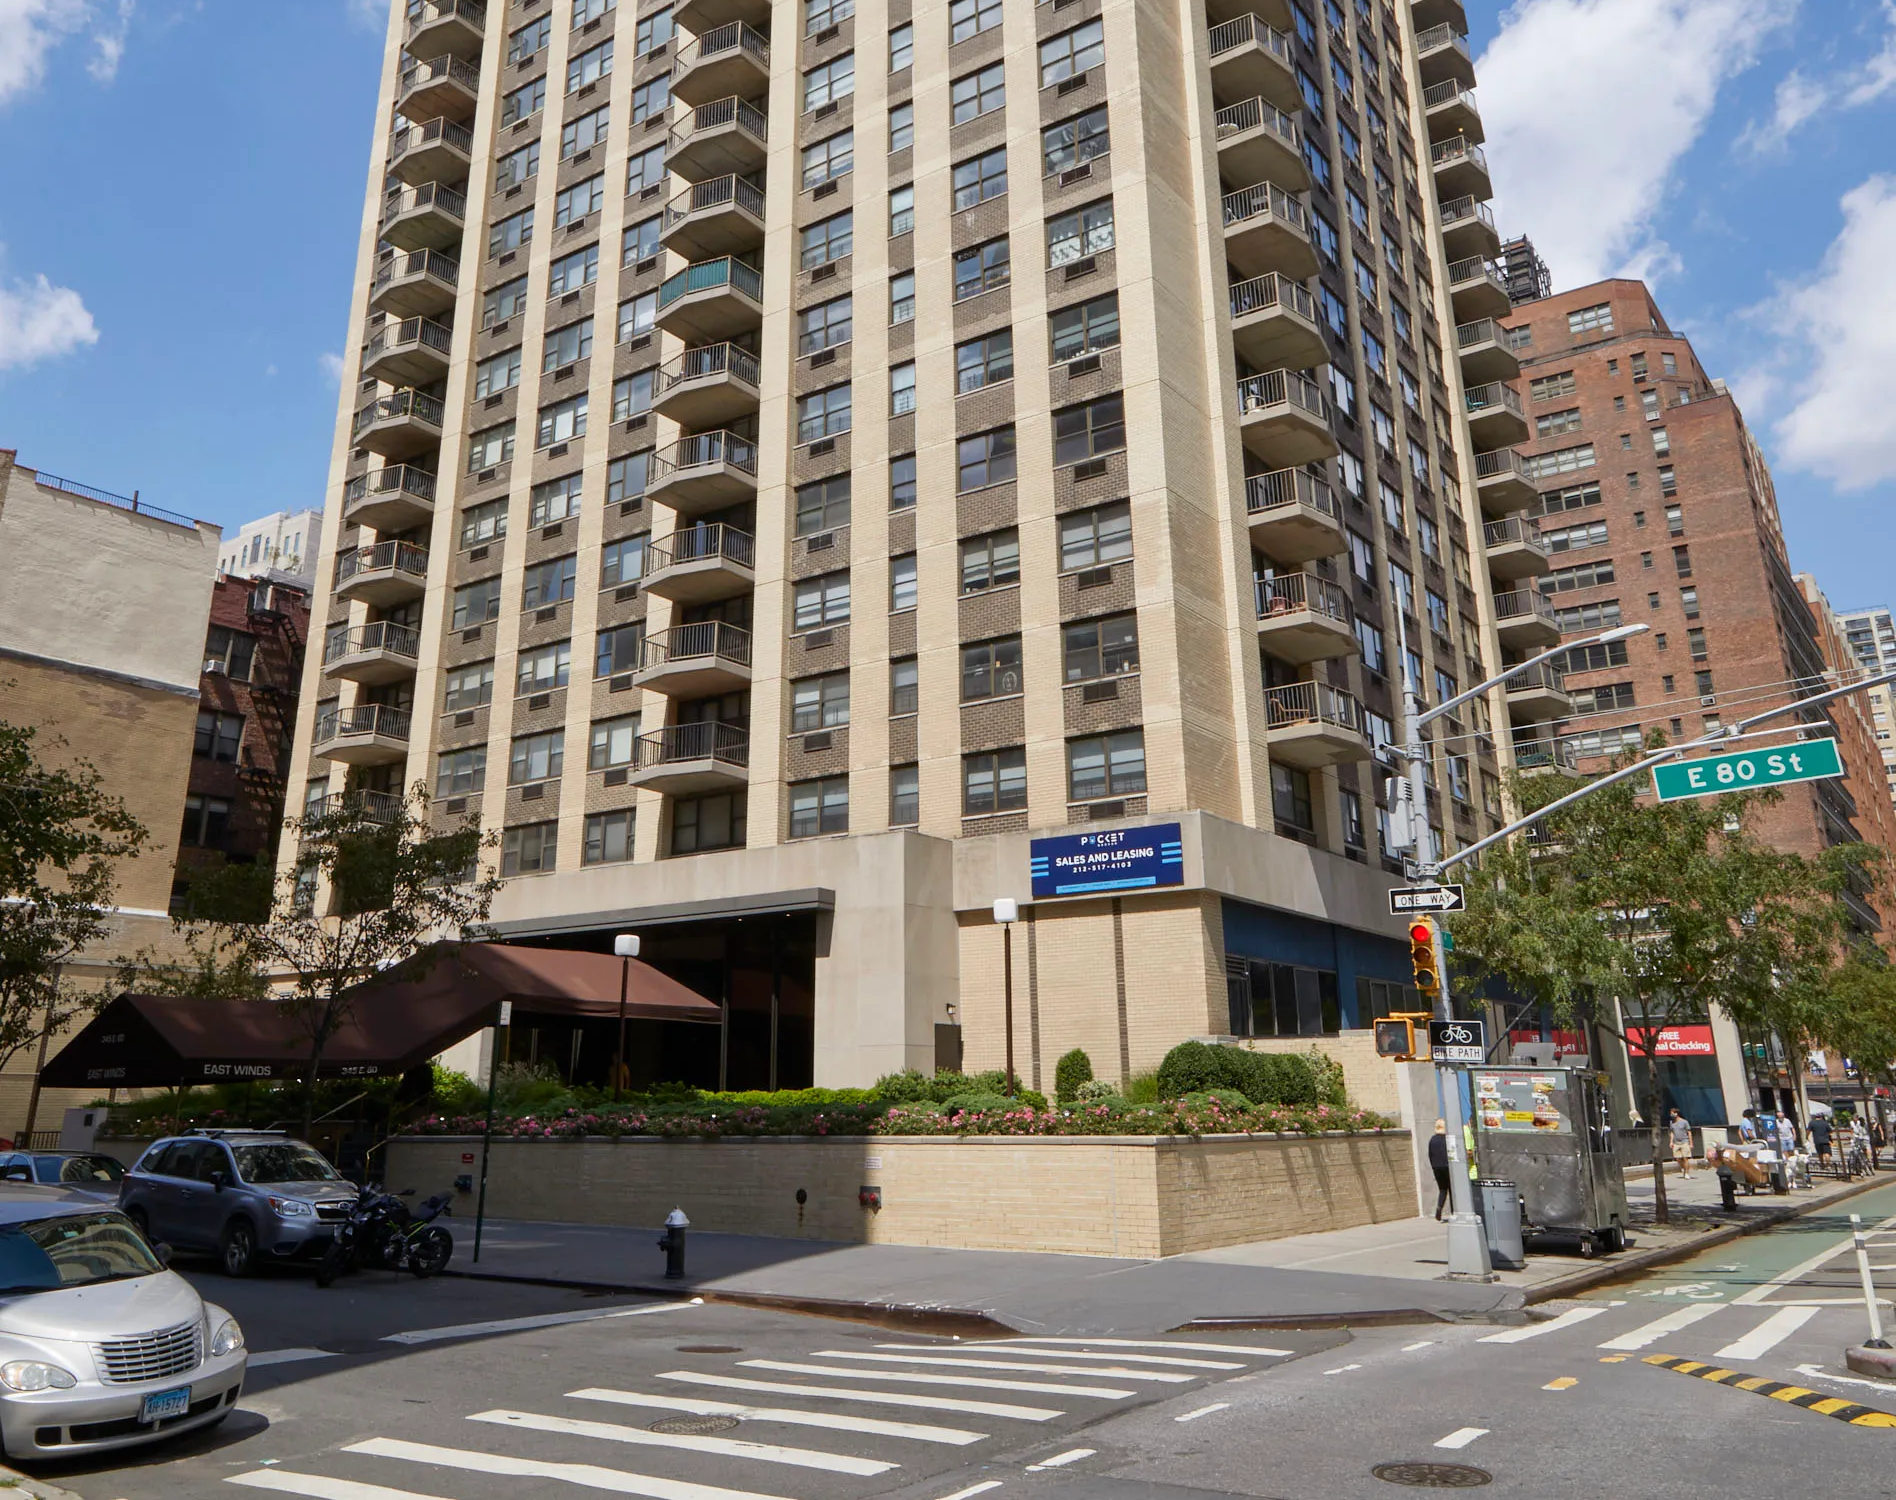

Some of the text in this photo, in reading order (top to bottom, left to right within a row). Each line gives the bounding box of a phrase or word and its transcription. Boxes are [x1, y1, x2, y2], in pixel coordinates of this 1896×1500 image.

[1687, 752, 1803, 789] E 80 St
[1056, 847, 1154, 867] SALES AND LEASING
[1073, 861, 1132, 873] 212-517-4103
[1400, 893, 1451, 906] ONE WAY
[1658, 1031, 1681, 1040] FREE
[1434, 1047, 1480, 1058] BIKE PATH
[1669, 1041, 1711, 1052] Checking
[204, 1064, 272, 1076] EAST WINDS
